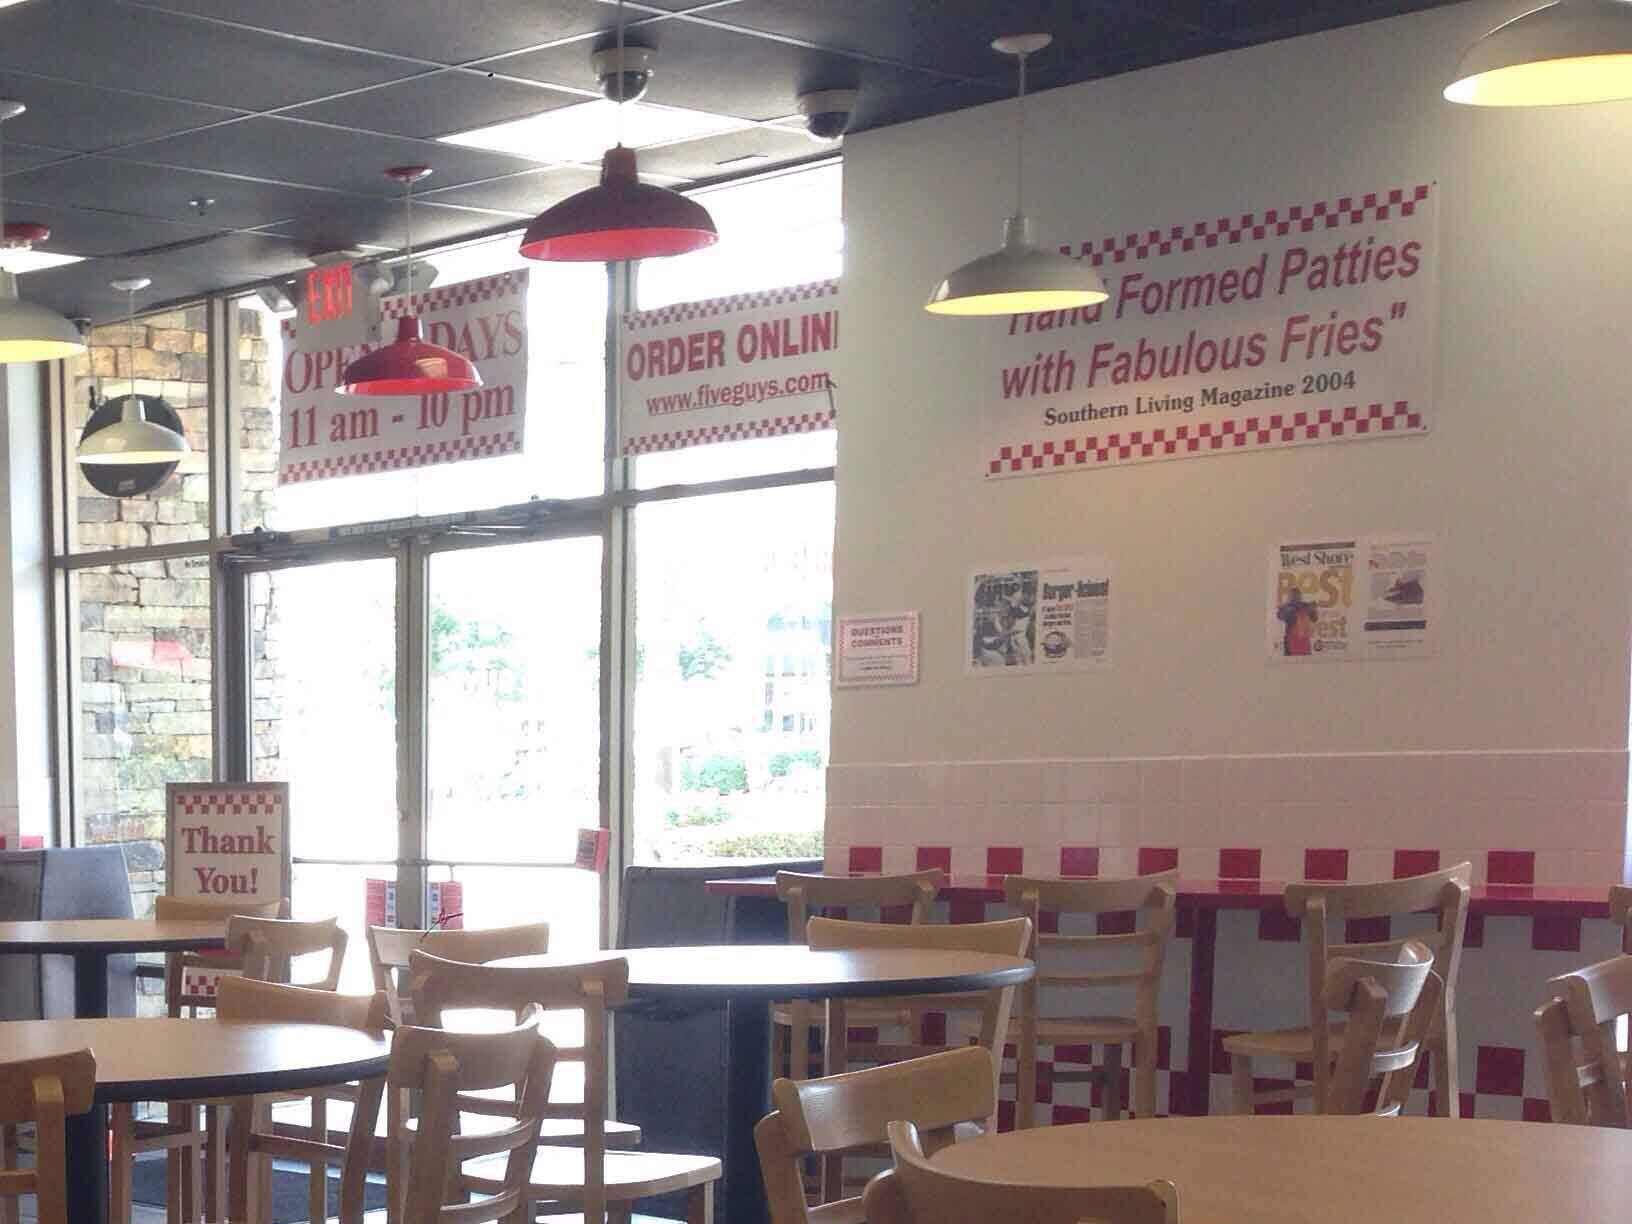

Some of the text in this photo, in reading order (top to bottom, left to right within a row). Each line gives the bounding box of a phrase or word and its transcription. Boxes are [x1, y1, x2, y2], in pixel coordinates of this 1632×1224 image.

[306, 262, 353, 322] EXIT
[1116, 252, 1268, 319] Formed
[1278, 236, 1422, 295] Patties
[428, 309, 524, 362] DAYS
[627, 310, 839, 381] ORDER ONLIN
[1001, 301, 1408, 399] with Fabulous Fries"
[288, 405, 318, 449] 11
[330, 407, 380, 442] am
[417, 392, 450, 430] 10
[462, 384, 515, 436] pm
[647, 372, 830, 416] www.fiveguys.com
[1044, 370, 1356, 426] Southern Living Magazine 2004
[181, 826, 276, 854] Thank
[193, 866, 259, 894] You!
